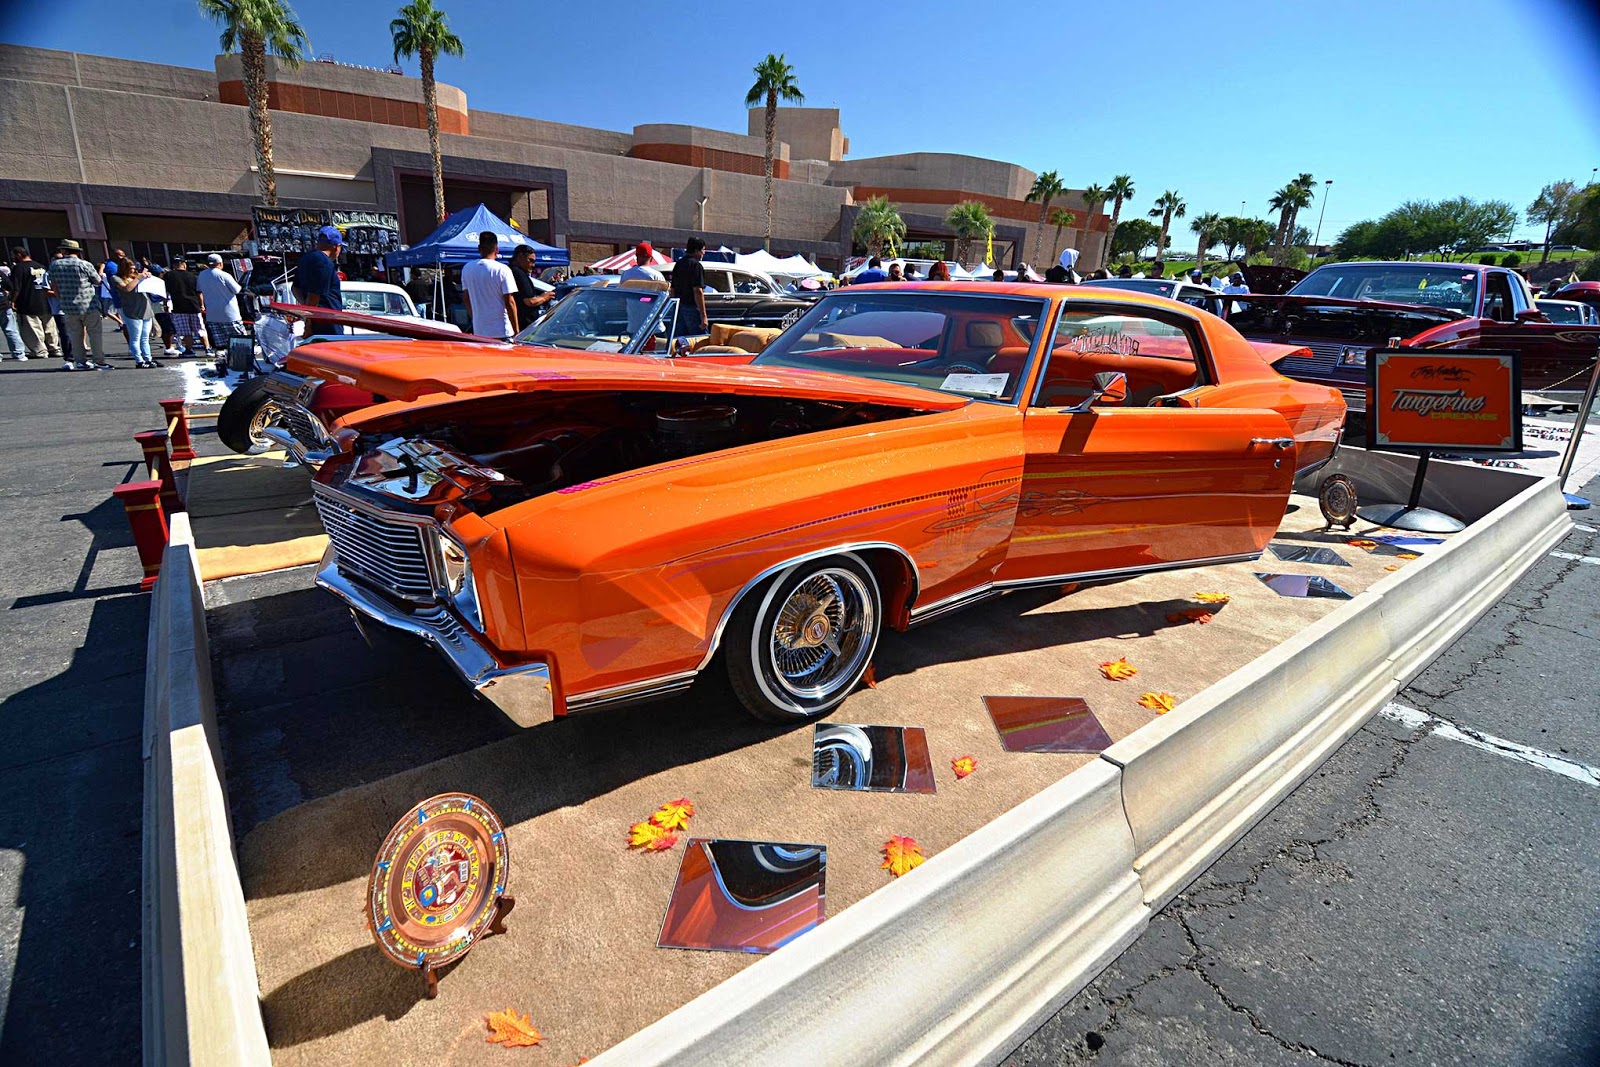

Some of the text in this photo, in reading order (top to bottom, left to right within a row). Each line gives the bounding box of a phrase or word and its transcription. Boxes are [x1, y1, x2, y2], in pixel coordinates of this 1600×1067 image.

[332, 211, 350, 226] Old
[350, 212, 380, 223] School
[380, 214, 399, 230] City
[1391, 388, 1486, 416] Tangerine
[1430, 411, 1499, 421] DREAMS
